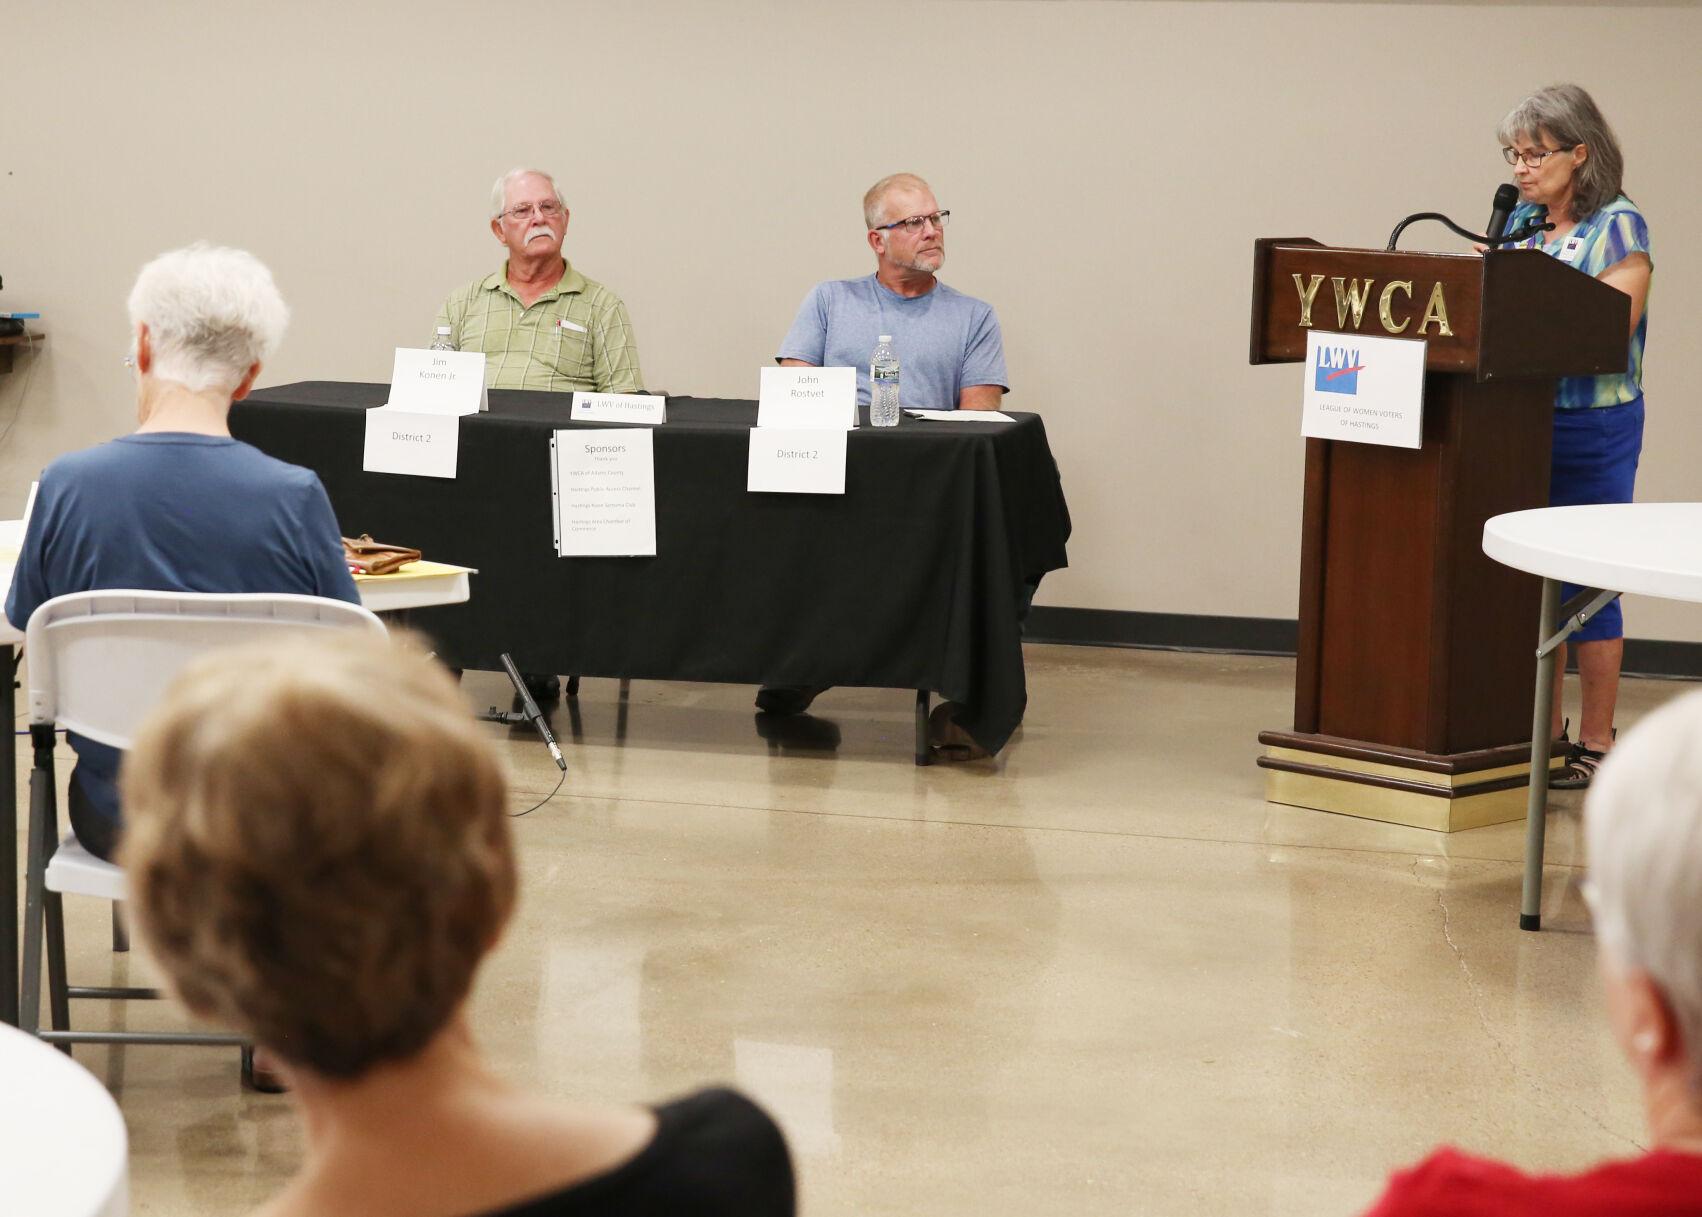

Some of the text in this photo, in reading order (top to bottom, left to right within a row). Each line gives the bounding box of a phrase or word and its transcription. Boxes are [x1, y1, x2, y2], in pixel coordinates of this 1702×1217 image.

[1292, 273, 1454, 337] YWCA
[432, 357, 447, 367] Jim
[1317, 345, 1360, 369] LWV
[419, 370, 456, 381] Konen Jr
[797, 375, 819, 385] John
[790, 389, 825, 399] Rostvet
[597, 400, 615, 409] LWV
[624, 401, 655, 412] Hastings
[1319, 404, 1403, 420] LEAGUE OF WOMEN VOTERS
[1340, 419, 1380, 431] OF HASTINGS
[392, 431, 432, 443] District 2
[584, 444, 626, 455] Sponsors
[777, 449, 819, 460] District 2
